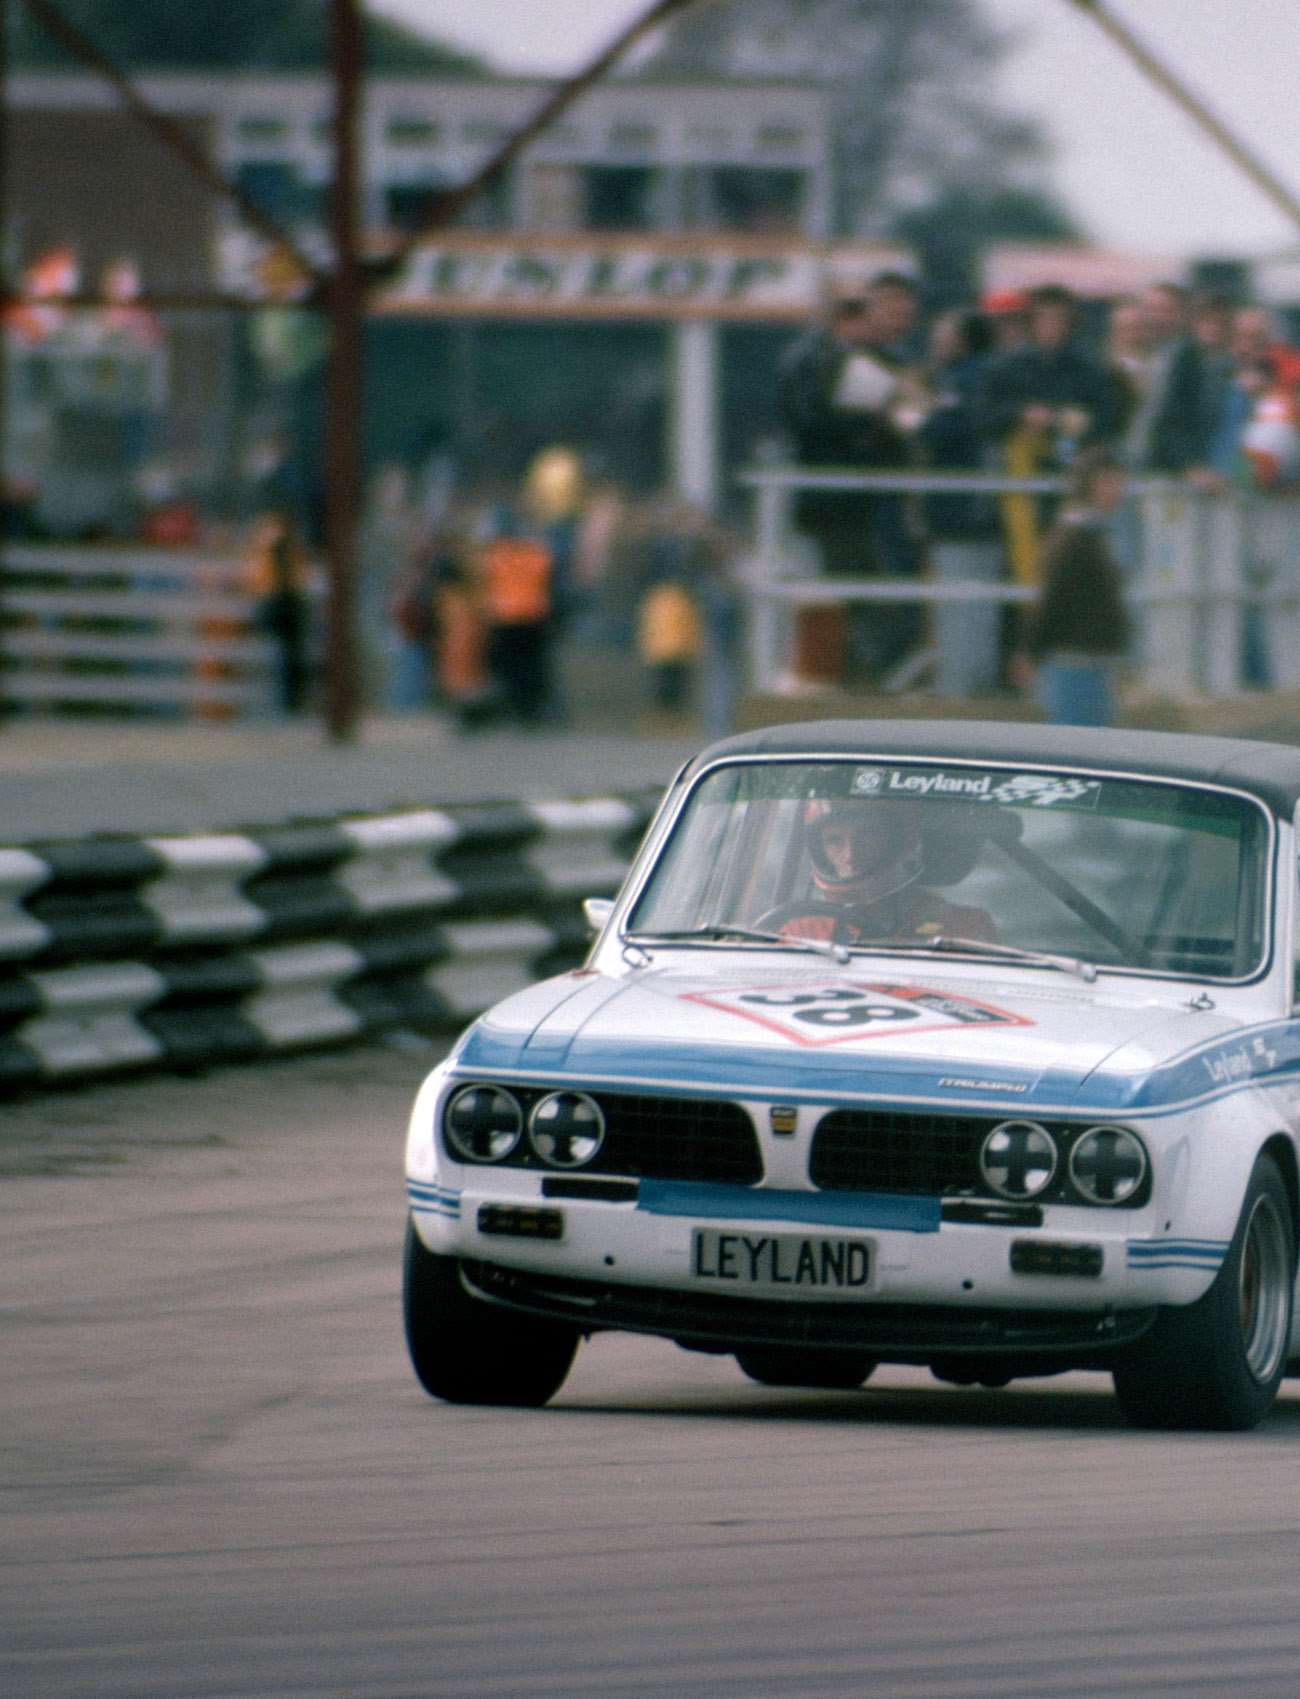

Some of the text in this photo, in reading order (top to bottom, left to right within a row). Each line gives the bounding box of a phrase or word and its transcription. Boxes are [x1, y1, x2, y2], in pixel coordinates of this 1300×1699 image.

[889, 772, 992, 793] Leyland
[738, 988, 922, 1027] 38
[696, 1233, 870, 1287] LEYLAND
